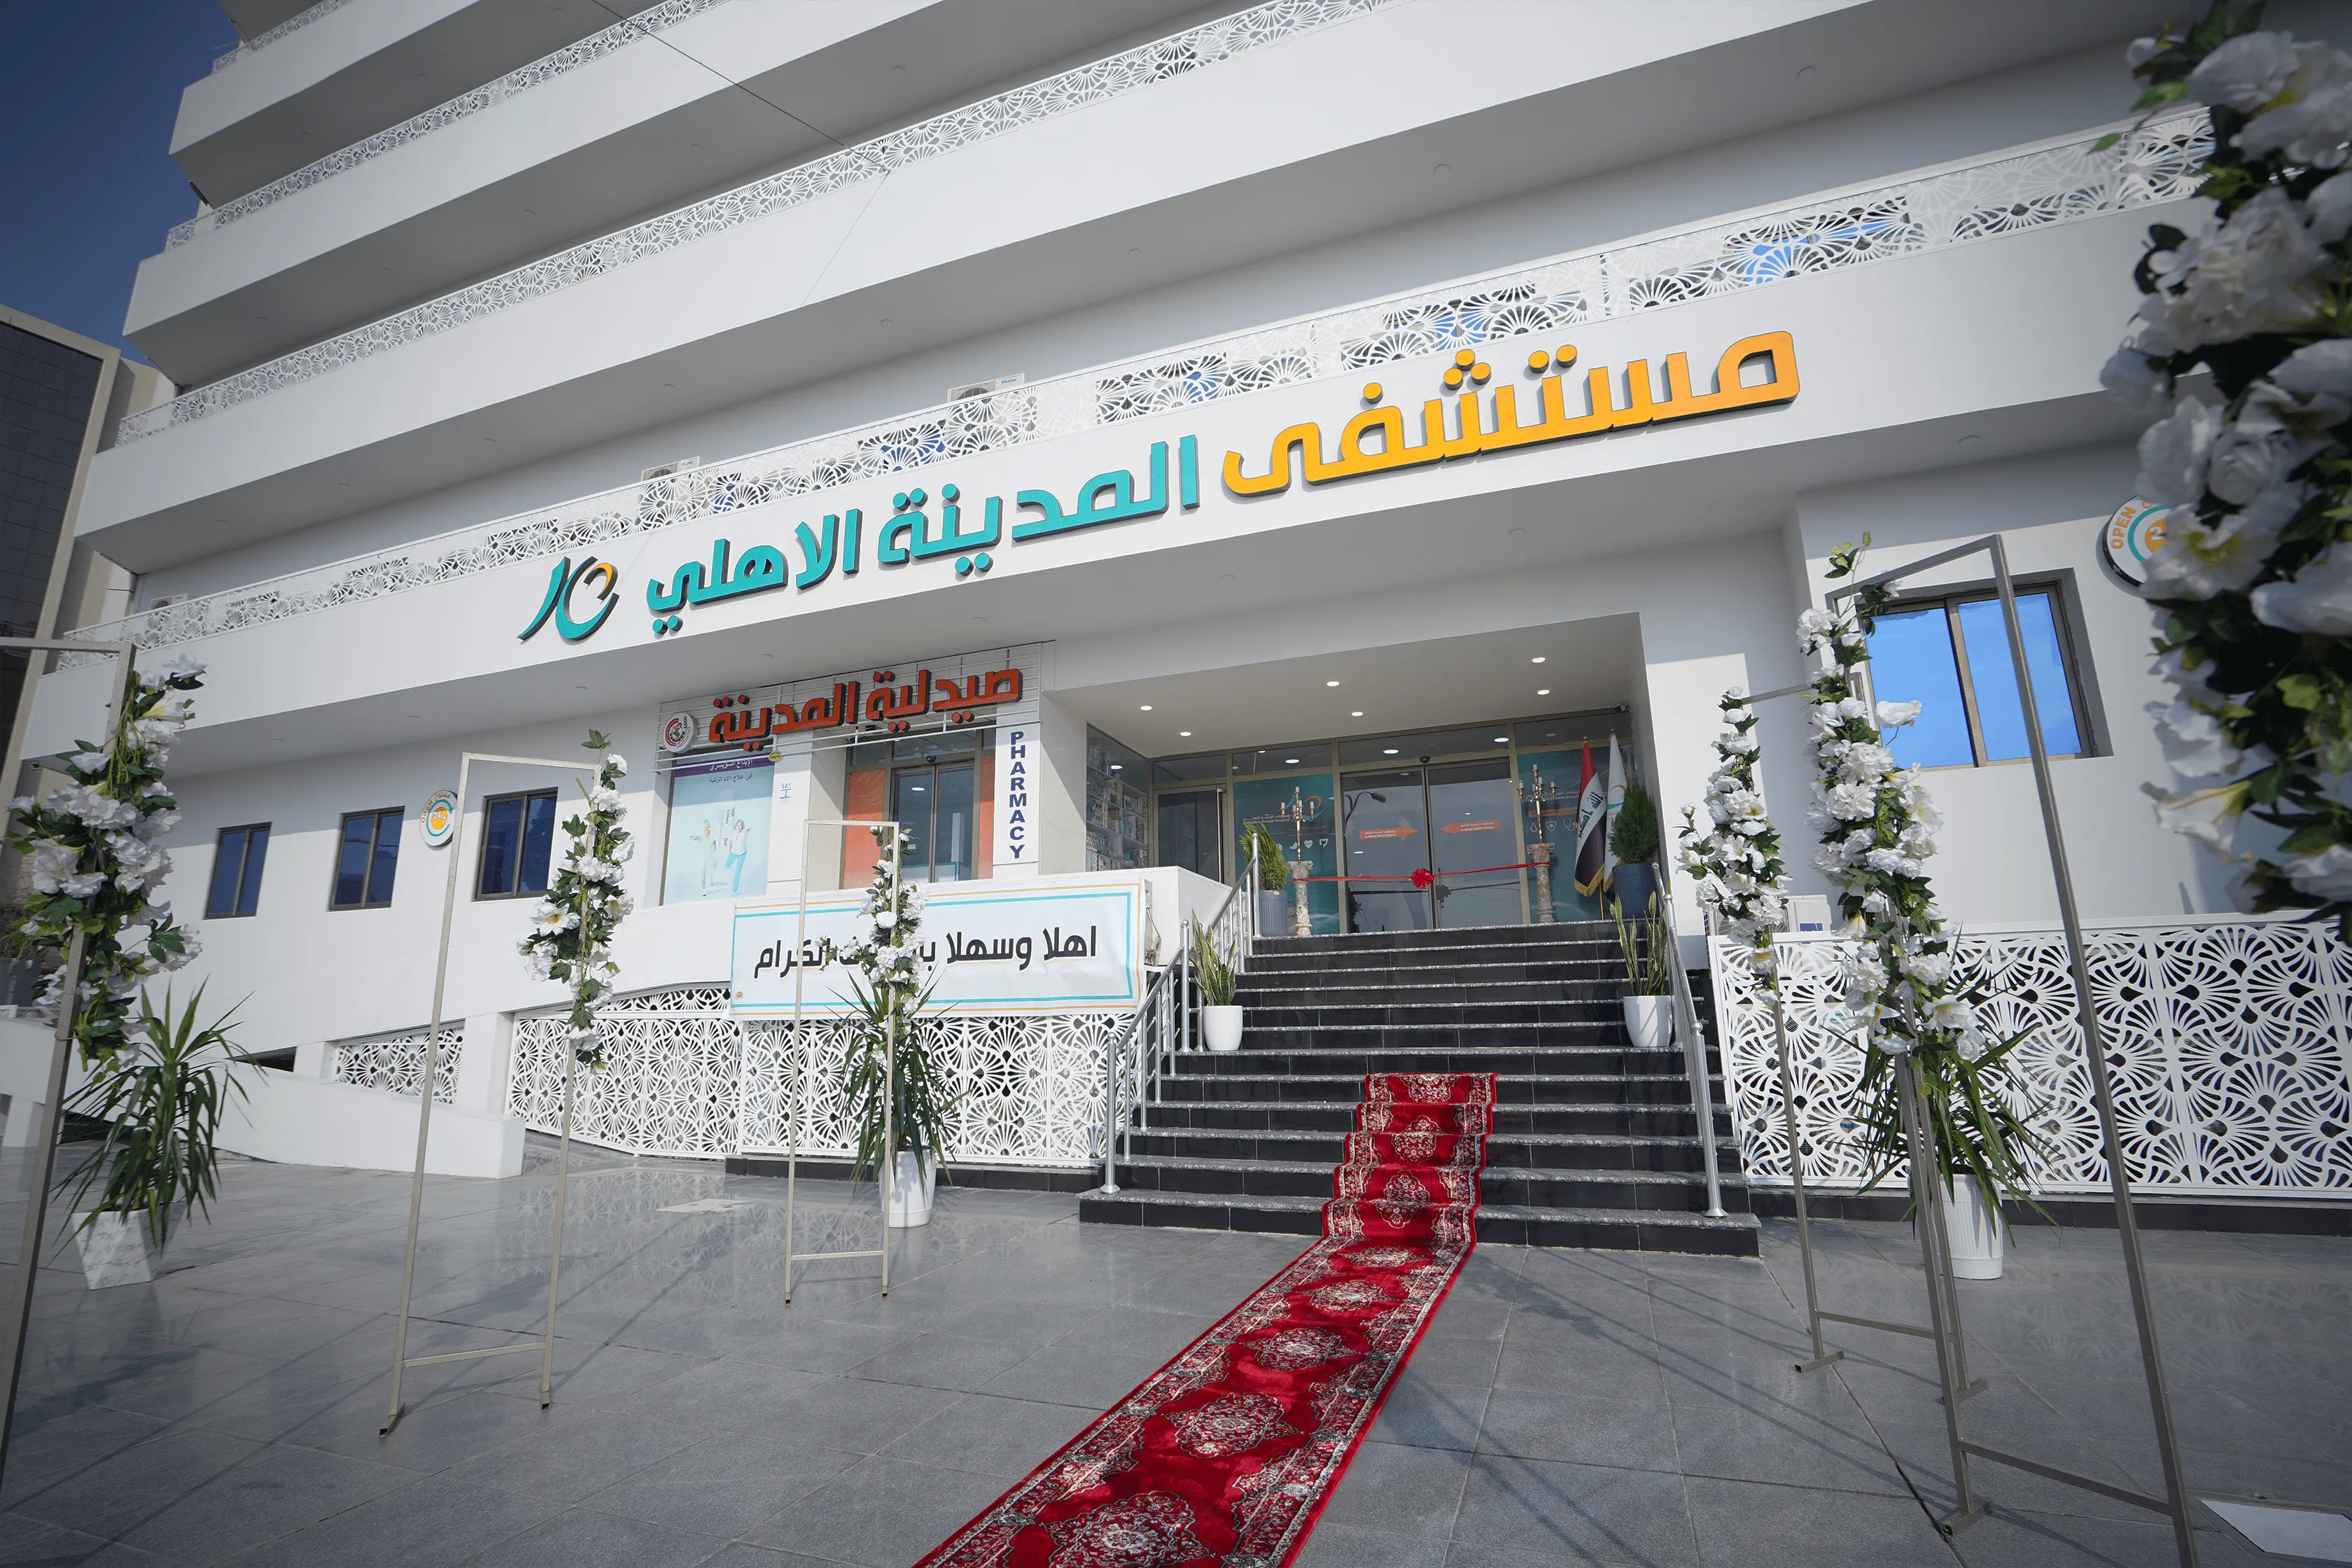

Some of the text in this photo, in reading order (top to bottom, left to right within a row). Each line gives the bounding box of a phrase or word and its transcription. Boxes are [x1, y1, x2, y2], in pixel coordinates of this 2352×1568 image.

[645, 330, 1800, 633] مستشفى المدينة الاهلي
[2110, 506, 2137, 550] OPEN
[708, 680, 861, 752] المدينة
[865, 668, 1023, 732] صيدلية
[421, 800, 433, 822] OPEN
[1009, 731, 1027, 859] PHARMACY
[753, 937, 833, 979] الكرام
[945, 931, 1032, 972] وسهلا
[1042, 925, 1097, 962] اهلا
